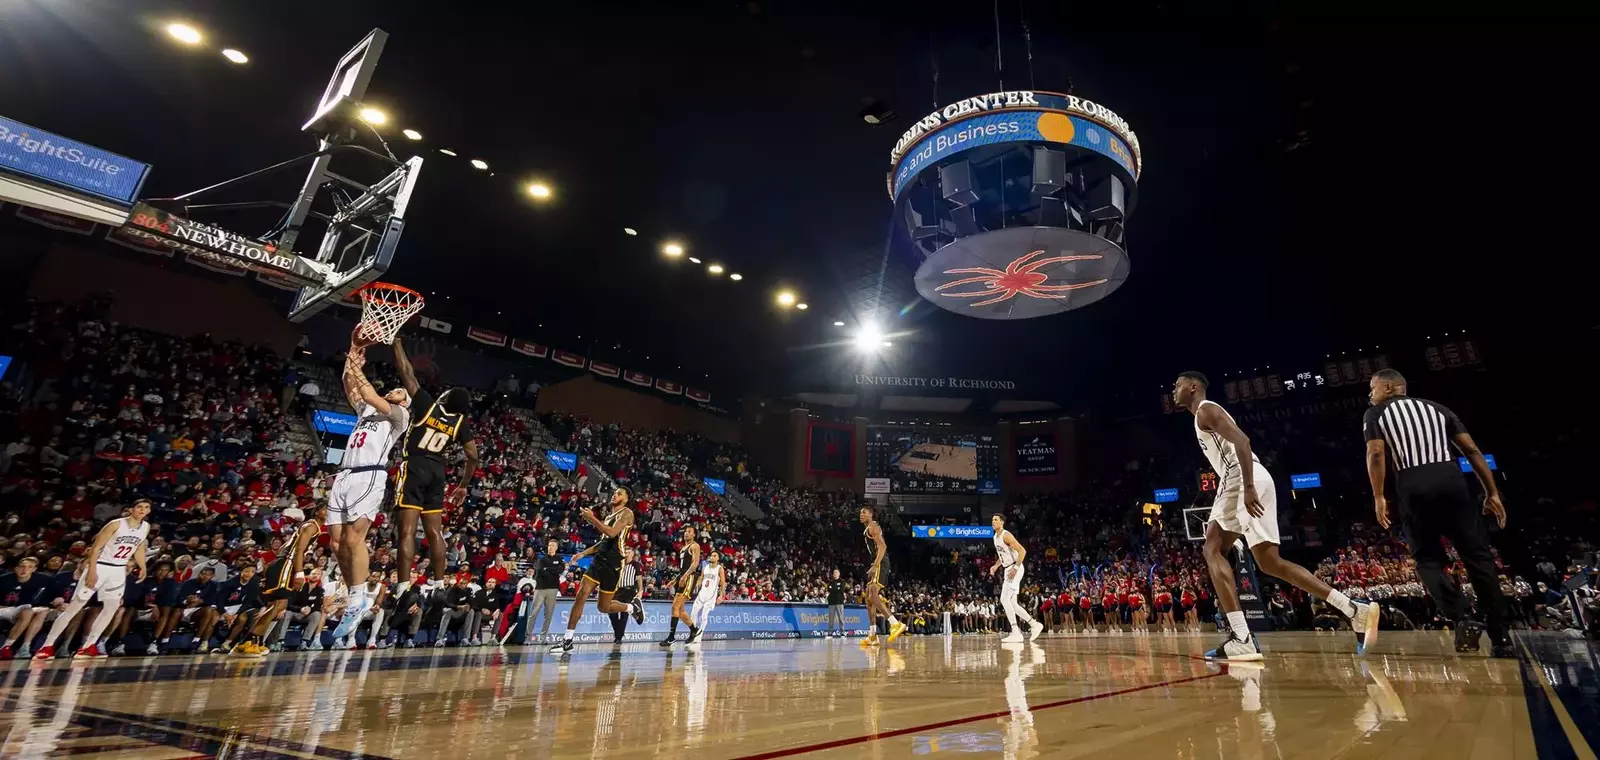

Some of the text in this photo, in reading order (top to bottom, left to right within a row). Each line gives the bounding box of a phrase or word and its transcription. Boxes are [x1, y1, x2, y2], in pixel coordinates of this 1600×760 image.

[943, 91, 1038, 120] CENTER
[910, 143, 932, 170] and
[936, 121, 1020, 152] Business
[855, 374, 1015, 390] UNIVERSITY OF RICHMOND
[350, 431, 368, 449] 33
[417, 427, 450, 453] 10
[1017, 447, 1055, 455] YEATMAN
[1202, 480, 1216, 491] 21
[955, 528, 991, 536] BrightSuite
[113, 545, 132, 559] 22
[561, 610, 611, 628] Scurity
[724, 612, 741, 624] and
[744, 611, 782, 625] Business
